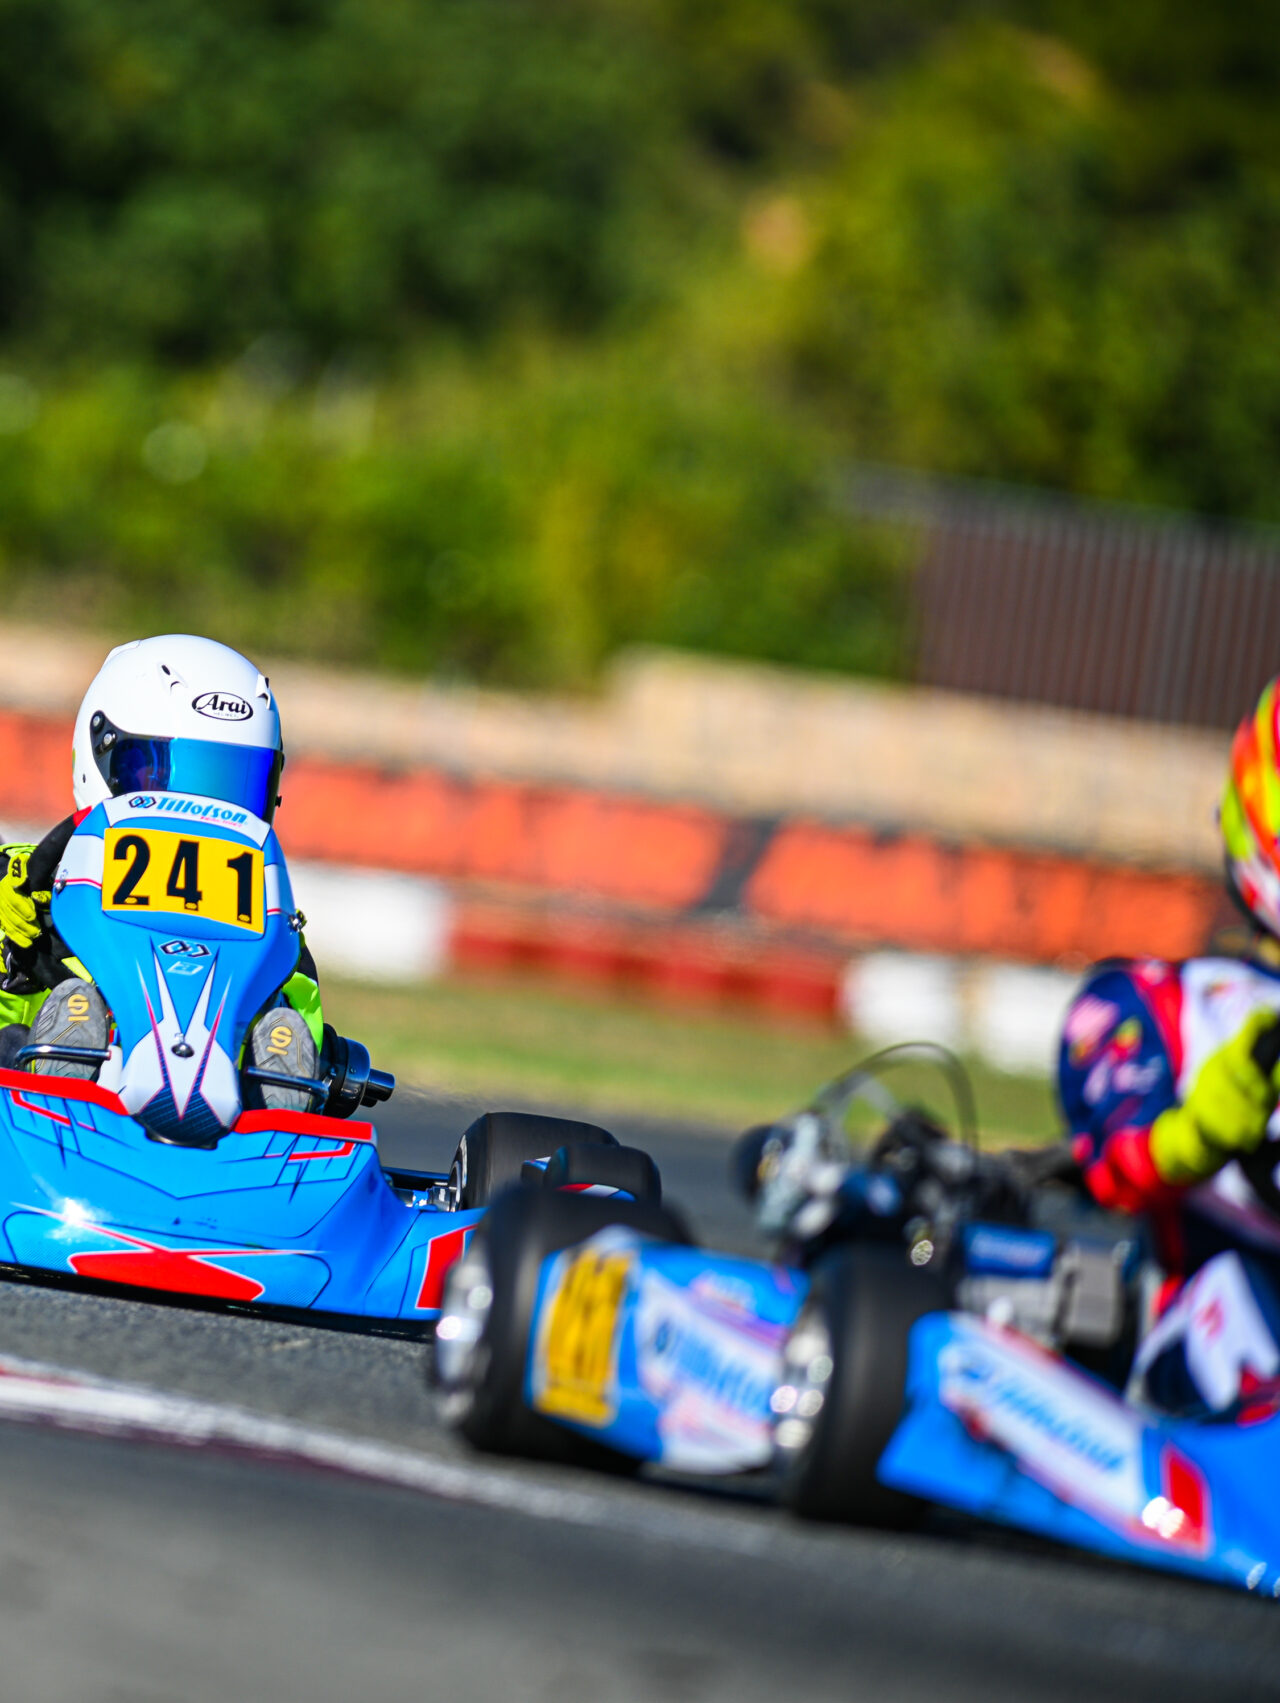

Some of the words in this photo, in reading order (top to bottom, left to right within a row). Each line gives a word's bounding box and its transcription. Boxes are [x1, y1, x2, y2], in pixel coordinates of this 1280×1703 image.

[196, 694, 247, 714] Arai
[157, 796, 248, 823] Tillotson
[112, 834, 254, 925] 241
